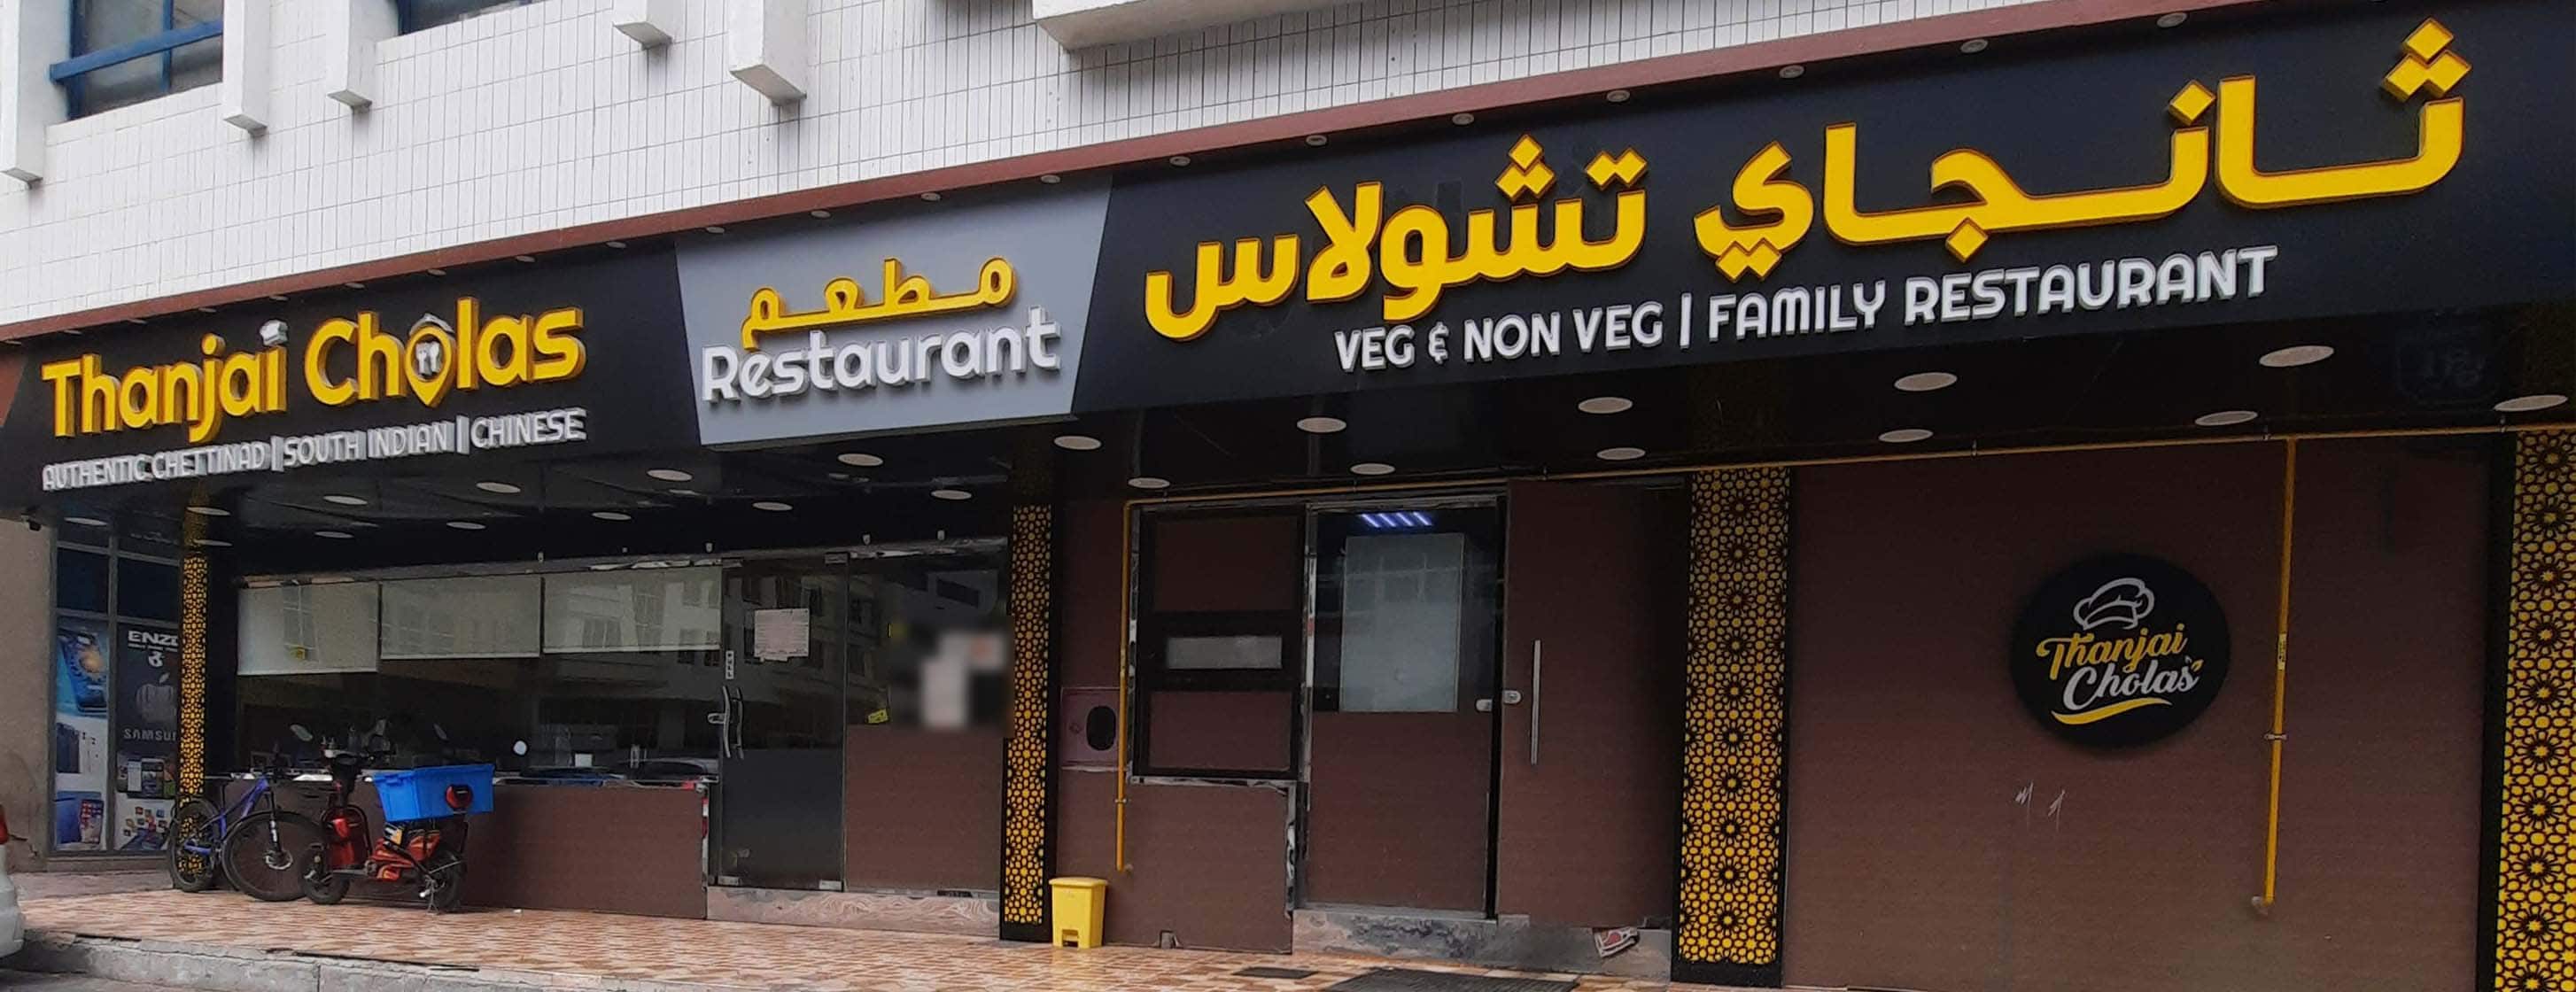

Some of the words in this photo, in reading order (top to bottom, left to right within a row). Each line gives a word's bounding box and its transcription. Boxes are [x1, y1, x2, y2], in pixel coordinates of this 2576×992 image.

[1693, 19, 2472, 282] ثانجاي
[1144, 135, 1648, 341] تشولاس
[741, 256, 1017, 352] مطعم
[1334, 324, 1415, 372] VEG
[1463, 312, 1561, 360] NON
[1572, 300, 1663, 351] VEG
[1709, 280, 1886, 340] FAMILY
[1905, 244, 2278, 325] RESTAURANT
[41, 320, 288, 443] Thanjai
[303, 297, 586, 407] Cholas
[702, 305, 1061, 402] Restaurant
[42, 453, 151, 491] AUTHENTIC
[151, 442, 269, 479] CHETTINAD
[283, 430, 367, 468] SOUTH
[367, 420, 455, 459] INDIAN
[470, 407, 587, 449] CHINESE
[2036, 623, 2188, 680] Thanjai
[2062, 658, 2200, 710] Cholas
